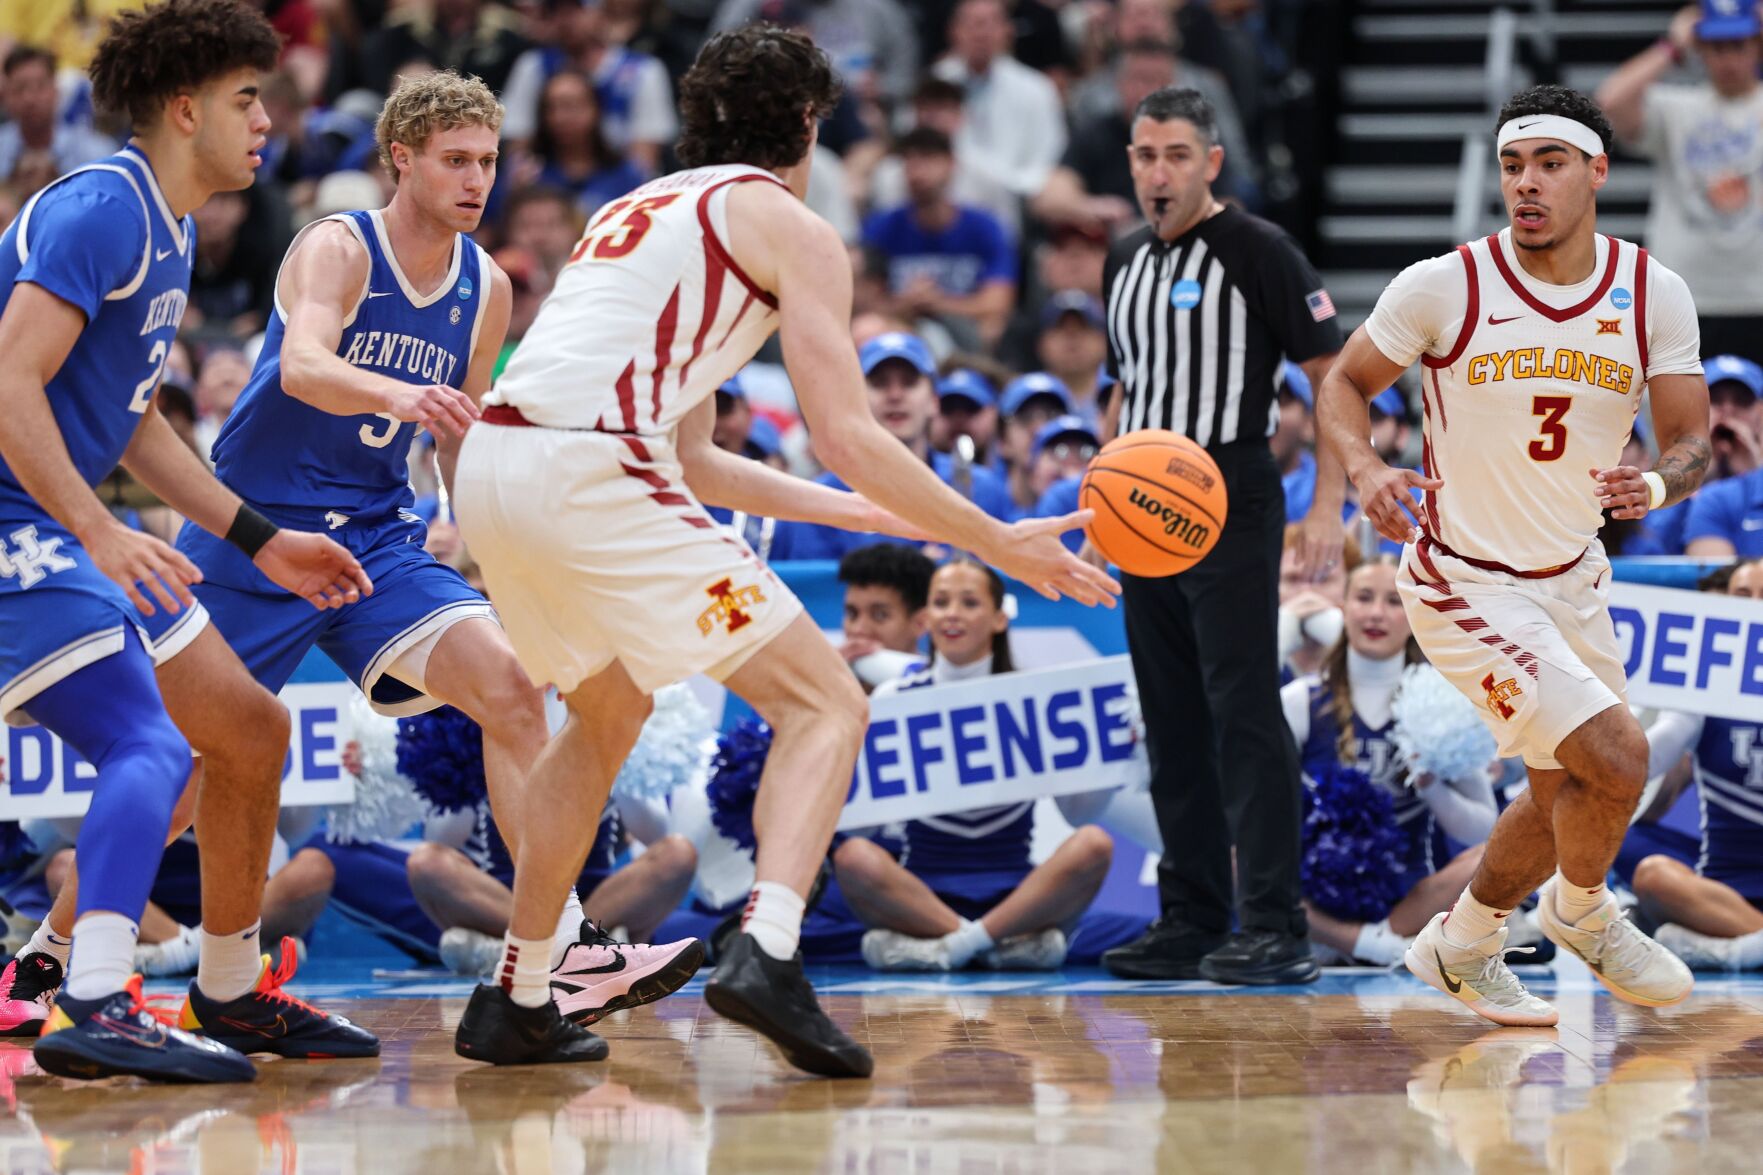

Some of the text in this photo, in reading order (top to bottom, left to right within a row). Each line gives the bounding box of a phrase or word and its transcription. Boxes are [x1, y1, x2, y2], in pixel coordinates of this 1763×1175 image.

[345, 331, 457, 385] KENTUCKY
[1468, 347, 1633, 394] CYCLONES
[1528, 395, 1573, 462] 3
[1128, 487, 1210, 549] Wilson
[847, 683, 1139, 804] EFENSE
